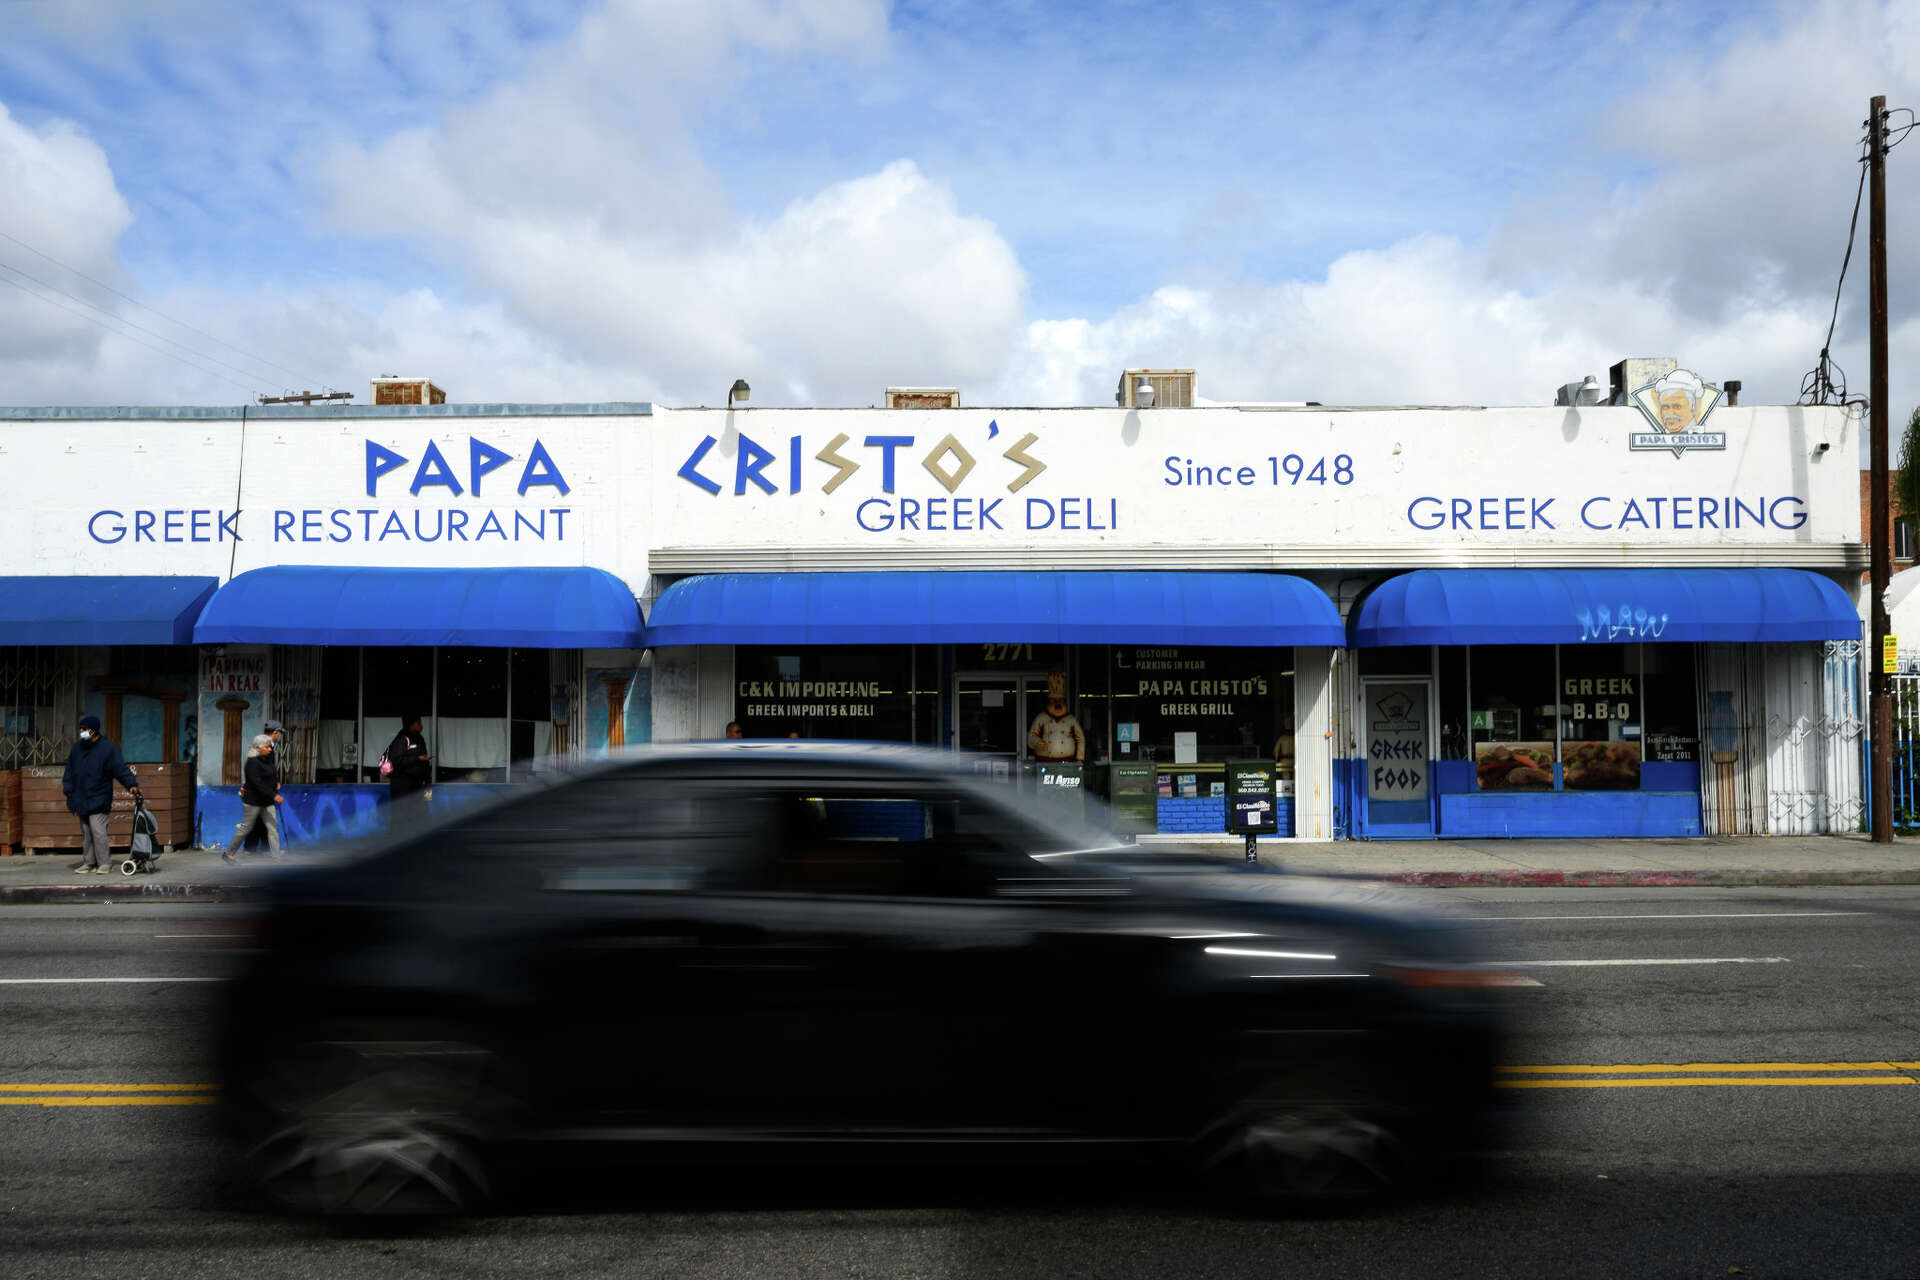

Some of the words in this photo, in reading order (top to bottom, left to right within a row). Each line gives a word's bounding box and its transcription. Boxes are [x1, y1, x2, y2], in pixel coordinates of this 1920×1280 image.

[1640, 434, 1667, 444] PAPA
[365, 437, 571, 497] PAPA
[677, 418, 1049, 497] CRISTO'S
[1165, 455, 1256, 486] Since
[1268, 454, 1355, 486] 1948
[856, 497, 1004, 533] GREEK
[1025, 497, 1118, 531] DELI
[1406, 496, 1556, 530] GREEK
[1580, 496, 1808, 530] CATERING
[88, 509, 243, 544] GREEK
[273, 508, 572, 544] RESTAURANT
[983, 643, 1033, 661] 2771
[1135, 648, 1179, 659] CUSTOMER
[208, 656, 264, 675] PARKING
[1135, 660, 1172, 671] PARKING
[1174, 660, 1183, 670] IN
[210, 674, 225, 692] IN
[228, 674, 261, 692] REAR
[739, 681, 775, 698] C&K
[779, 681, 880, 698] IMPORTING
[1138, 680, 1185, 697] PAPA
[1190, 677, 1268, 697] CRISTO'S
[1565, 677, 1635, 696] GREEK
[747, 704, 785, 717] GREEK
[787, 704, 838, 717] IMPORTS
[839, 704, 848, 717] &
[849, 704, 874, 717] DELI
[1161, 703, 1198, 716] GREEK
[1200, 703, 1235, 716] GRILL
[1474, 714, 1485, 727] A
[1120, 727, 1130, 738] A
[1369, 738, 1423, 761] GREEK
[1043, 774, 1054, 785] El
[1374, 766, 1422, 791] FOOD
